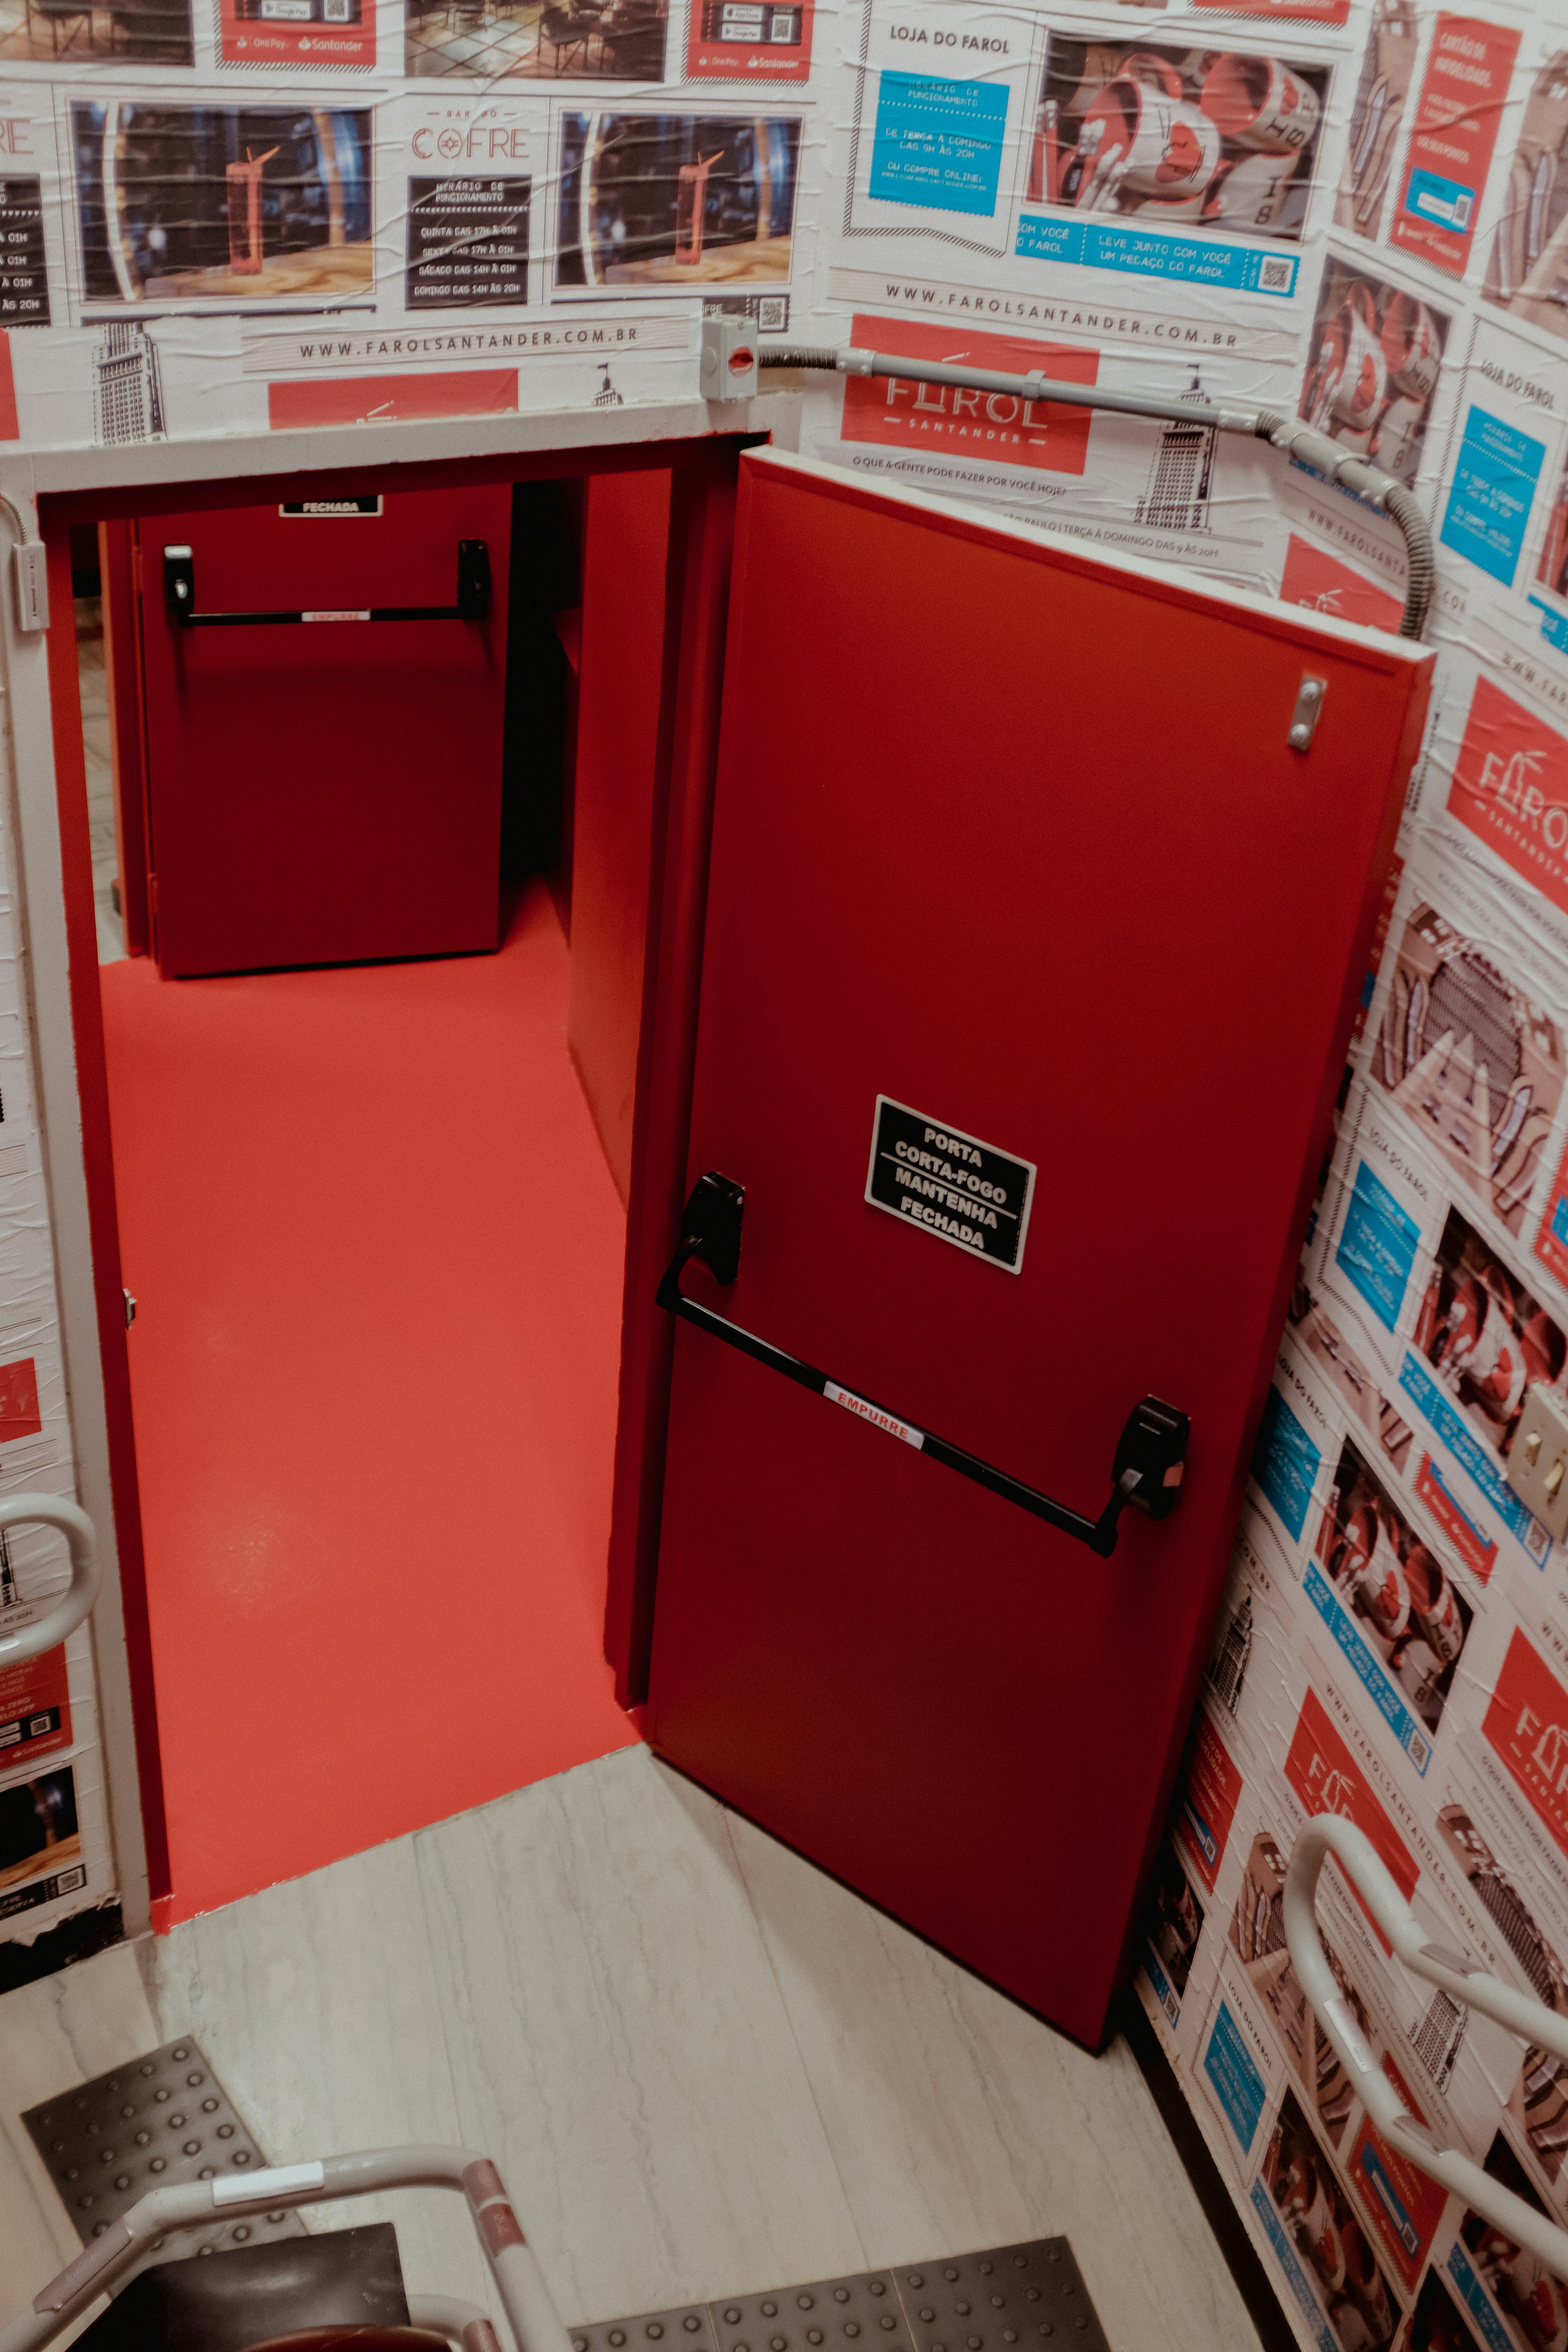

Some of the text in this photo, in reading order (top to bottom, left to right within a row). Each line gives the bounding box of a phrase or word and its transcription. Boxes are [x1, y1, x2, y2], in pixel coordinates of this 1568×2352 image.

[312, 39, 363, 52] Santander
[890, 25, 1009, 54] LOJA DO FAROL
[412, 127, 529, 159] COFRE
[903, 163, 940, 177] COMPRE
[436, 192, 505, 202] FUNCIONAMENTO
[8, 232, 28, 243] 01H
[421, 226, 452, 239] QUINTA
[454, 226, 471, 236] DAS
[474, 226, 490, 235] 17H
[471, 245, 487, 254] 17H
[498, 245, 514, 254] 01H
[1028, 238, 1063, 254] FAROL
[1098, 235, 1232, 265] LEVE JUNTO COM VOCÊ
[7, 256, 27, 265] 01H
[418, 264, 452, 275] SÁBADO
[454, 265, 470, 274] DAS
[473, 264, 489, 274] 14H
[500, 264, 517, 274] 01H
[1100, 250, 1225, 279] UM PEDAÇO DO FAROL
[13, 277, 33, 287] 01H
[414, 285, 450, 296] DOMINGO
[453, 285, 469, 294] DAS
[472, 284, 488, 294] 14H
[503, 283, 521, 293] 20H
[19, 299, 40, 309] 20H
[885, 284, 1238, 348] WWW.FAROLSANTANDER.COM.BR
[300, 327, 638, 359] WWW.FAROLSANTANDER.COM.BR
[1506, 372, 1523, 392] DO
[909, 418, 1021, 444] SANTANDER
[853, 456, 861, 465] O
[863, 457, 884, 468] QUE
[884, 460, 893, 469] A
[894, 461, 925, 474] GENTE
[927, 465, 953, 479] PODE
[955, 469, 985, 483] FAZER
[986, 475, 1007, 486] POR
[1009, 477, 1036, 491] VOCÊ
[302, 502, 359, 513] FECHADA
[1063, 523, 1093, 539] TERÇA
[1103, 531, 1154, 548] DOMINGO
[1155, 537, 1175, 551] DAS
[1489, 810, 1561, 876] SANTANDER
[924, 1127, 983, 1168] PORTA
[895, 1140, 1007, 1205] CORTA-FOGO
[895, 1166, 998, 1230] MANTENHA
[900, 1195, 985, 1250] FECHADA
[837, 1392, 909, 1440] EMPURRE
[1243, 2010, 1253, 2034] DO
